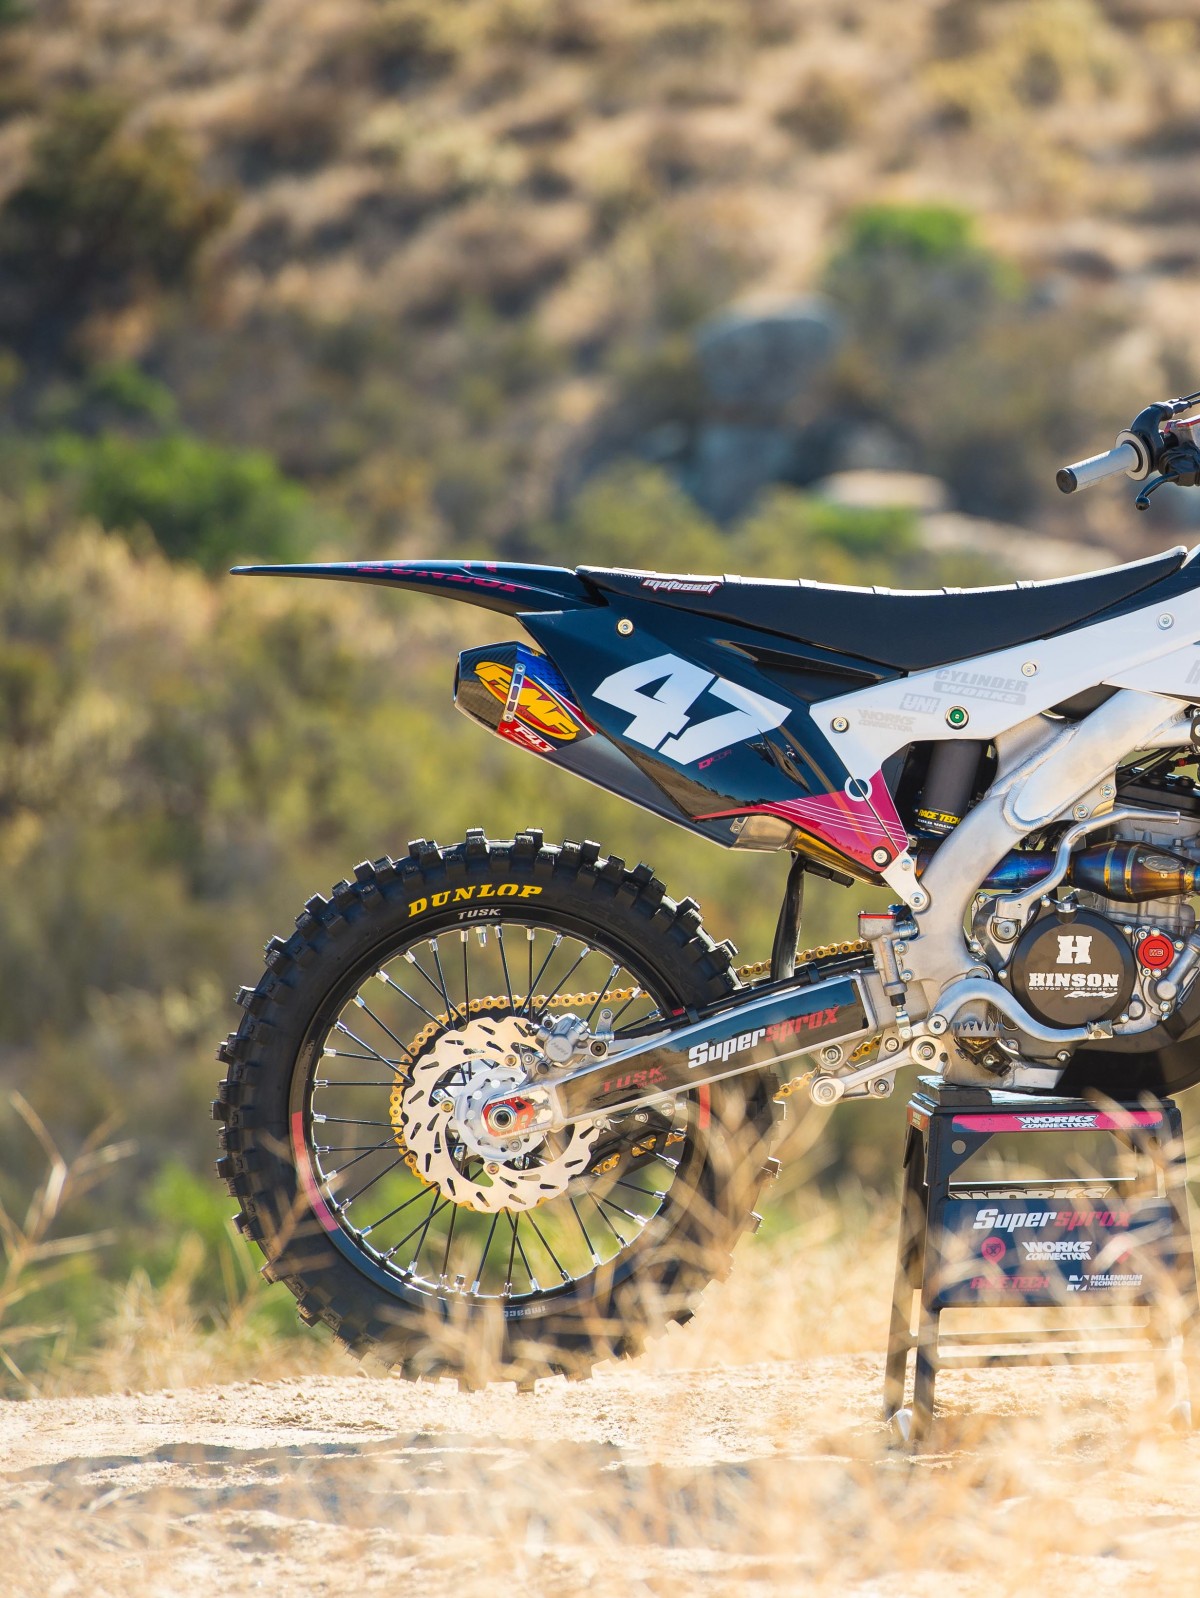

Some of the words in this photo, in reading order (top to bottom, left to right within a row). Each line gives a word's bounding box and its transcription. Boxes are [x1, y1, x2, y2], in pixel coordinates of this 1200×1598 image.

[935, 669, 1029, 692] CYLINDER
[941, 684, 1019, 703] WORKS
[592, 653, 793, 766] 47
[408, 884, 543, 918] DUNLOP
[458, 908, 501, 920] TUSK
[1056, 935, 1093, 964] H
[1029, 972, 1119, 987] HINSON
[687, 1005, 840, 1068] Supersprox
[602, 1064, 664, 1092] TUSK
[1016, 1115, 1097, 1124] WORKS
[973, 1208, 1131, 1232] Supersprox
[1022, 1241, 1092, 1253] WORKS
[1025, 1252, 1091, 1260] CONNECTION
